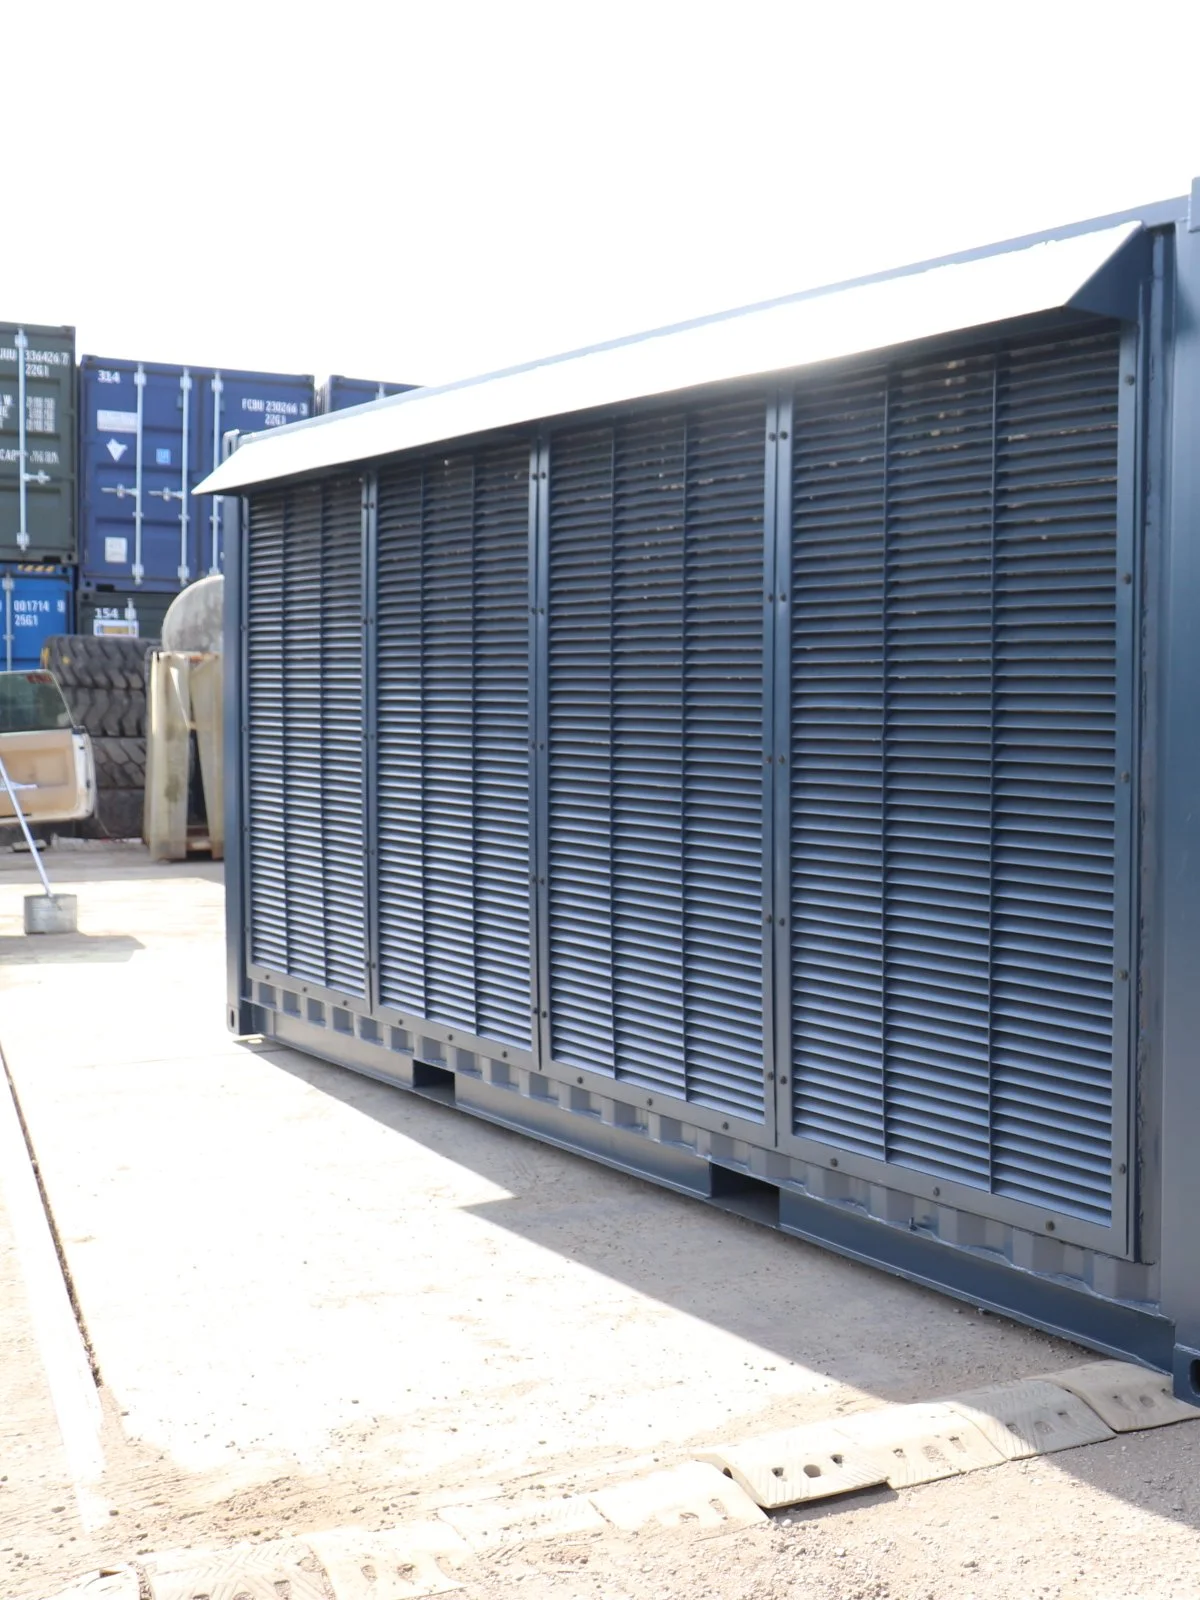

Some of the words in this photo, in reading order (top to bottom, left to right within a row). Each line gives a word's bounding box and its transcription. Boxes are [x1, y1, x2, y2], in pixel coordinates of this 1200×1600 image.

[98, 369, 121, 384] 314
[13, 600, 50, 613] 001714
[95, 607, 118, 619] 154
